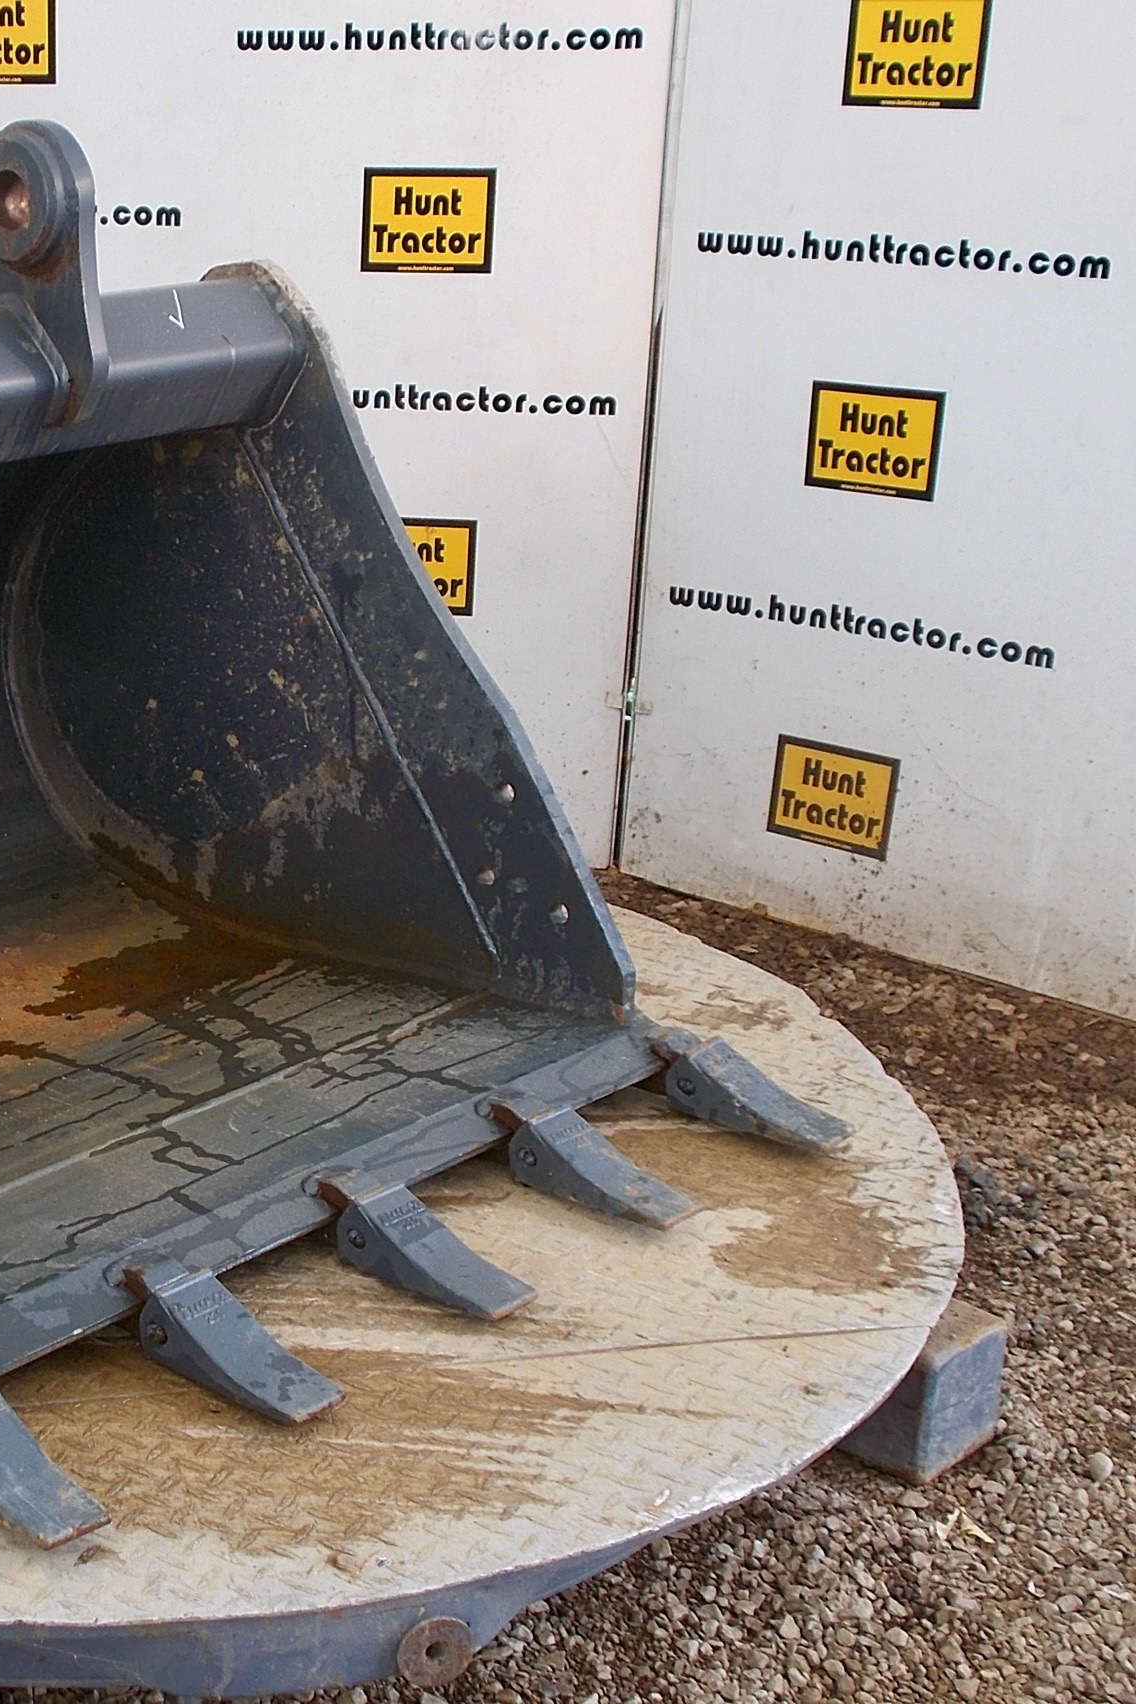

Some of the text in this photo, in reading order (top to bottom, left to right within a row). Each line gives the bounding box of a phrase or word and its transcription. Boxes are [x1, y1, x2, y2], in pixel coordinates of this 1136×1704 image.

[237, 22, 644, 51] www.hunttractor.com
[880, 10, 954, 43] Hunt
[857, 52, 973, 87] Tractor
[393, 186, 462, 216] Hunt
[372, 224, 482, 254] Tractor
[697, 230, 1112, 280] www.hunttractor.com
[352, 383, 617, 416] unttractor.com
[839, 402, 908, 438] Hunt
[817, 438, 926, 480] Tractor
[669, 585, 1054, 669] www.hunttractor.com
[802, 756, 867, 799] Hunt
[781, 788, 881, 839] Tractor
